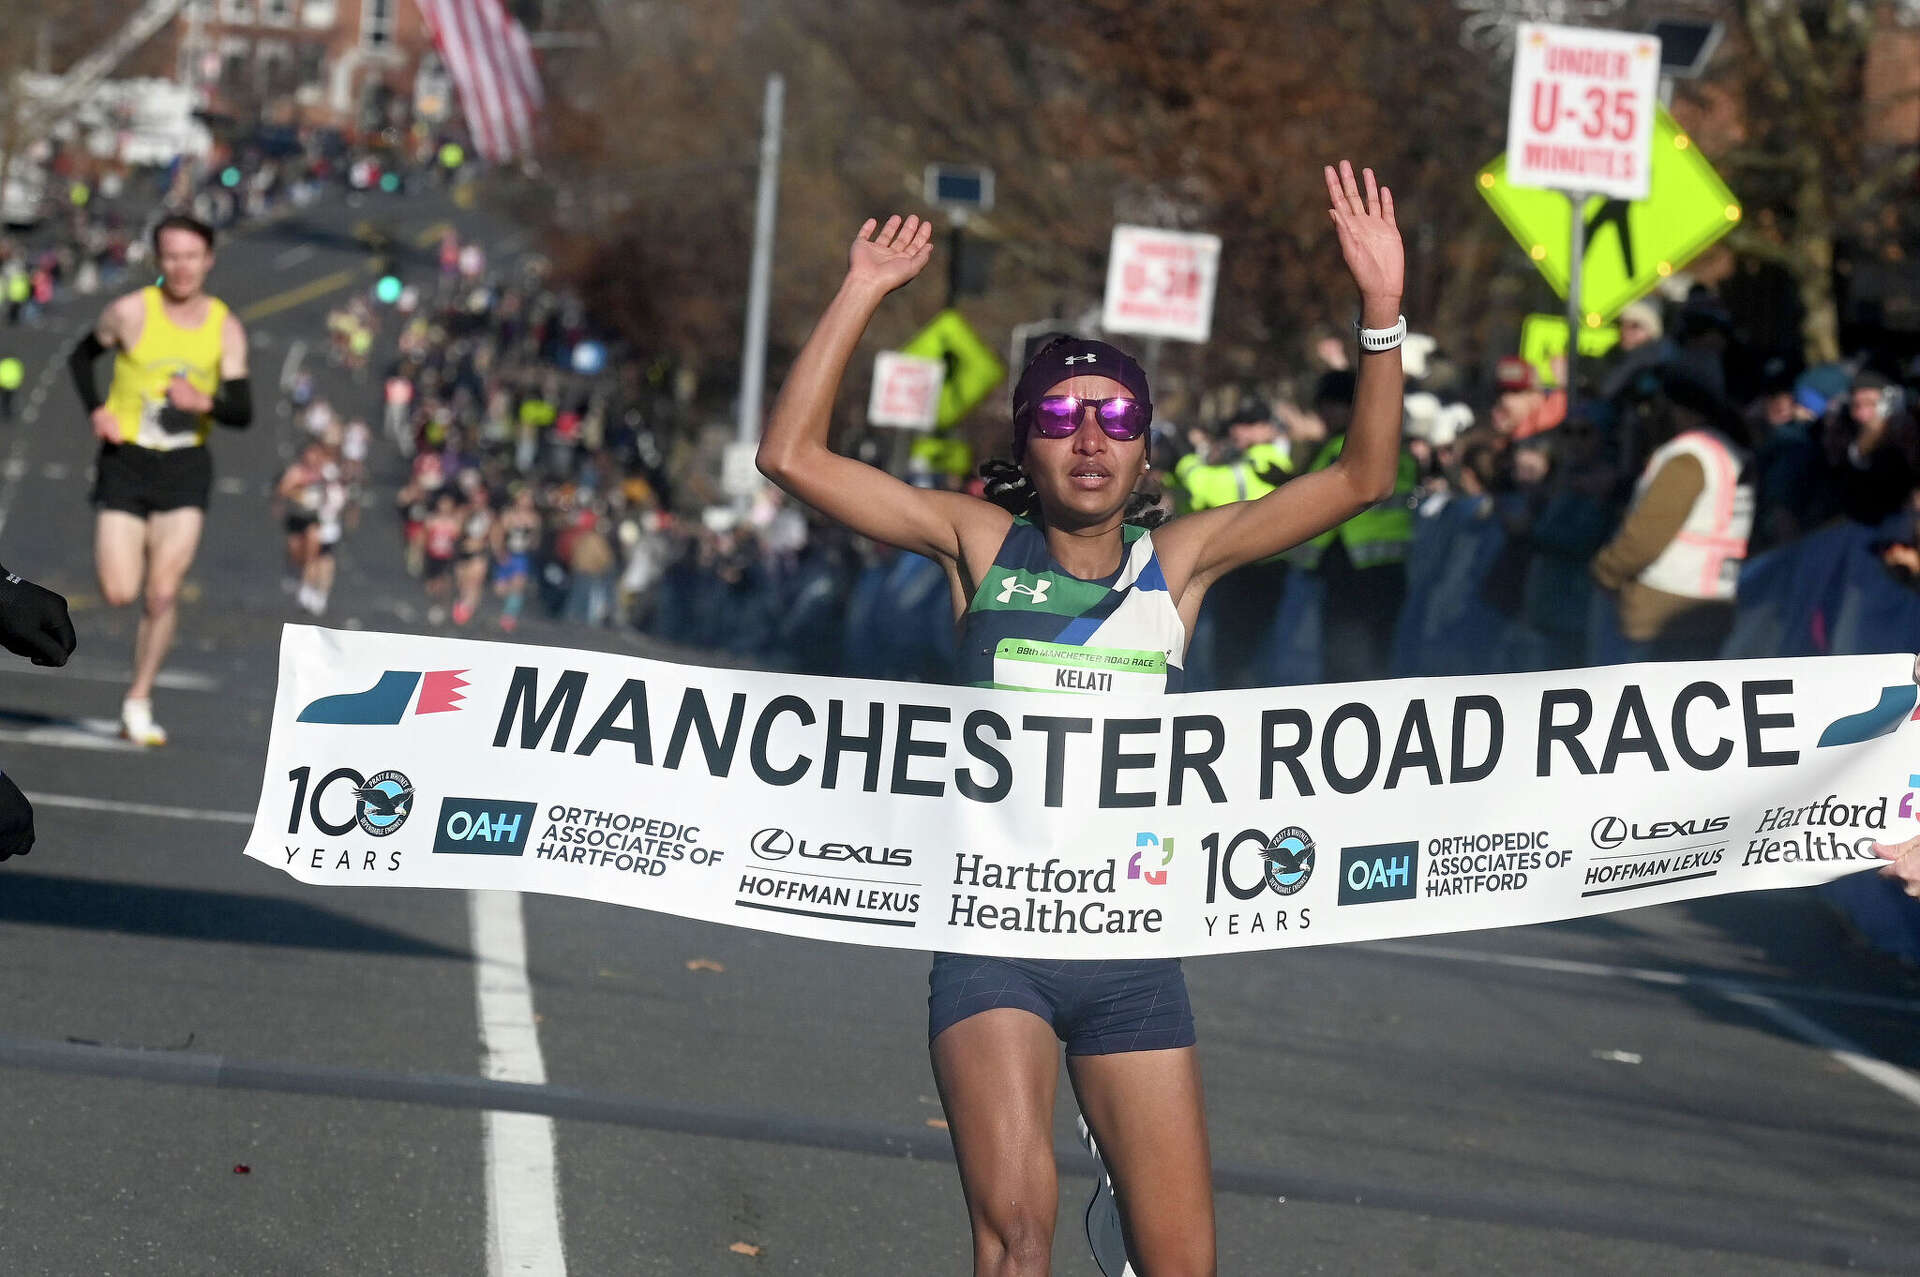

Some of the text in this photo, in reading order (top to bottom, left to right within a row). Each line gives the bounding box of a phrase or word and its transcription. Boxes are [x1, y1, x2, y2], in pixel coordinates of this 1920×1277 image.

[1531, 81, 1638, 142] U-35
[1039, 649, 1103, 663] MANCHESTER
[1104, 655, 1130, 665] ROAD
[1132, 658, 1155, 667] RACE
[1056, 668, 1112, 692] KELATI
[493, 667, 1800, 808] MANCHESTER ROAD RACE
[368, 773, 385, 787] PRATT
[447, 811, 522, 842] OAH
[549, 806, 700, 843] ORTHOPEDIC
[1632, 816, 1730, 840] LEXUS
[1755, 795, 1887, 834] Hartford
[285, 847, 402, 871] YEARS
[537, 843, 667, 877] HARTFORD
[542, 824, 724, 866] ASSOCIATES OF
[799, 840, 912, 866] LEXUS
[1428, 831, 1548, 856] ORTHOPEDIC
[1742, 831, 1878, 866] HealthC
[953, 853, 1115, 893] Hartford
[1348, 856, 1409, 891] OAH
[1428, 850, 1572, 877] ASSOCIATES OF
[1585, 849, 1726, 885] HOFFMAN LEXUS
[739, 875, 920, 912] HOFFMAN LEXUS
[1426, 873, 1527, 897] HARTFORD
[948, 894, 1162, 933] HealthCare
[1205, 908, 1310, 936] YEARS
